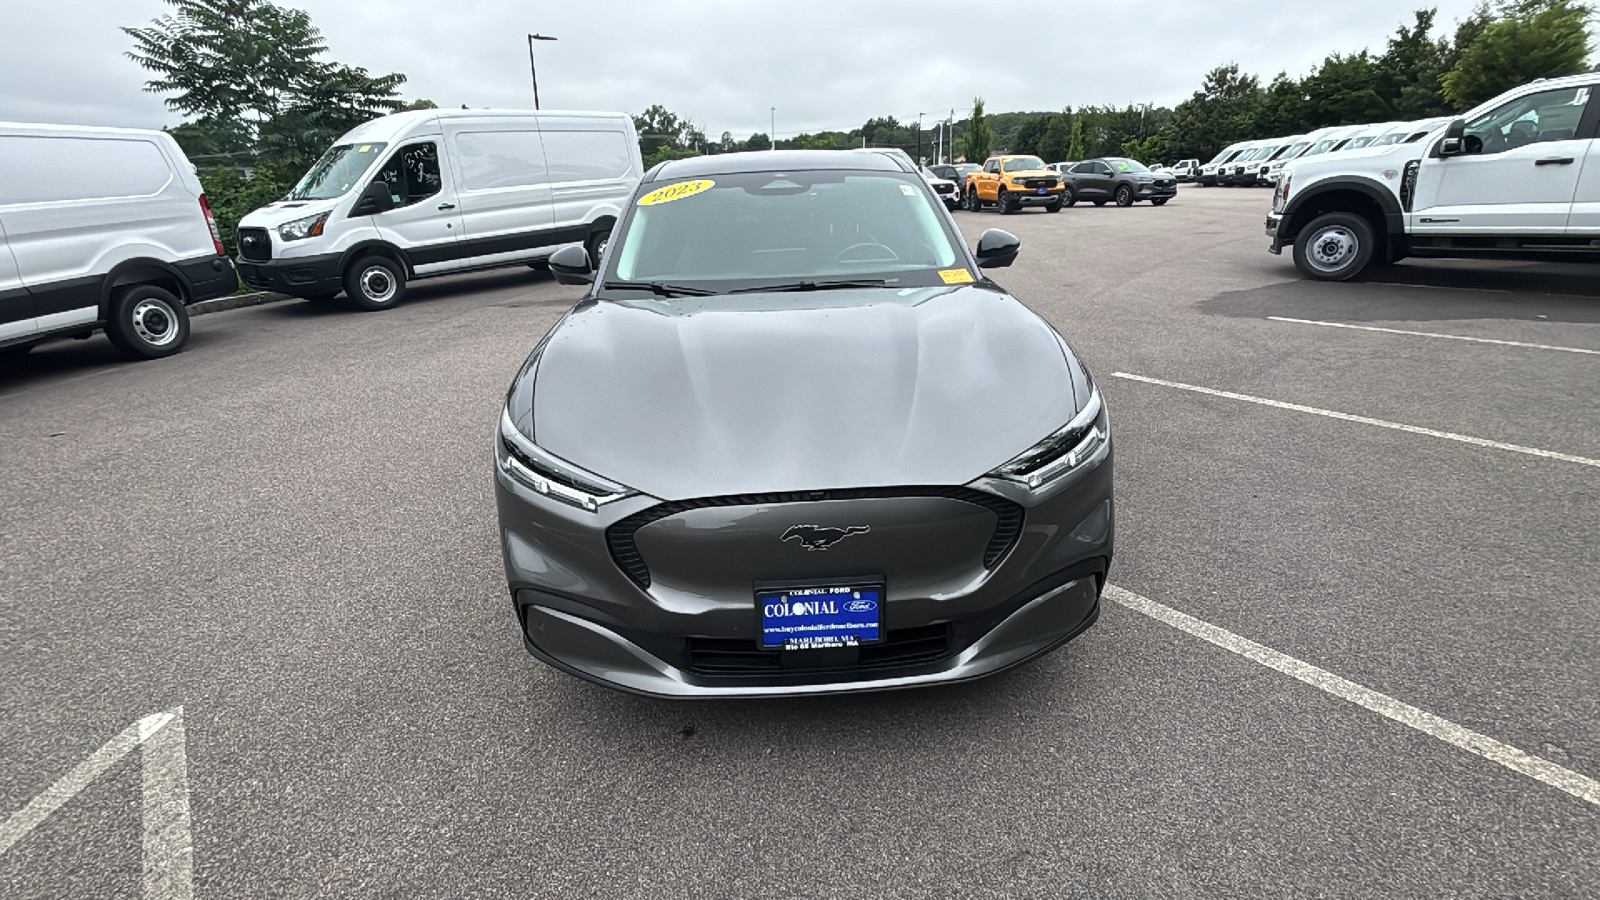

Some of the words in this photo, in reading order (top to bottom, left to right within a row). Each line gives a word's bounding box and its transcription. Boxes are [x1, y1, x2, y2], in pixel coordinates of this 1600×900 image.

[652, 182, 702, 202] 2023
[764, 601, 839, 618] COLONIAL
[763, 622, 879, 634] www.buycolonialfordmarlboro.com
